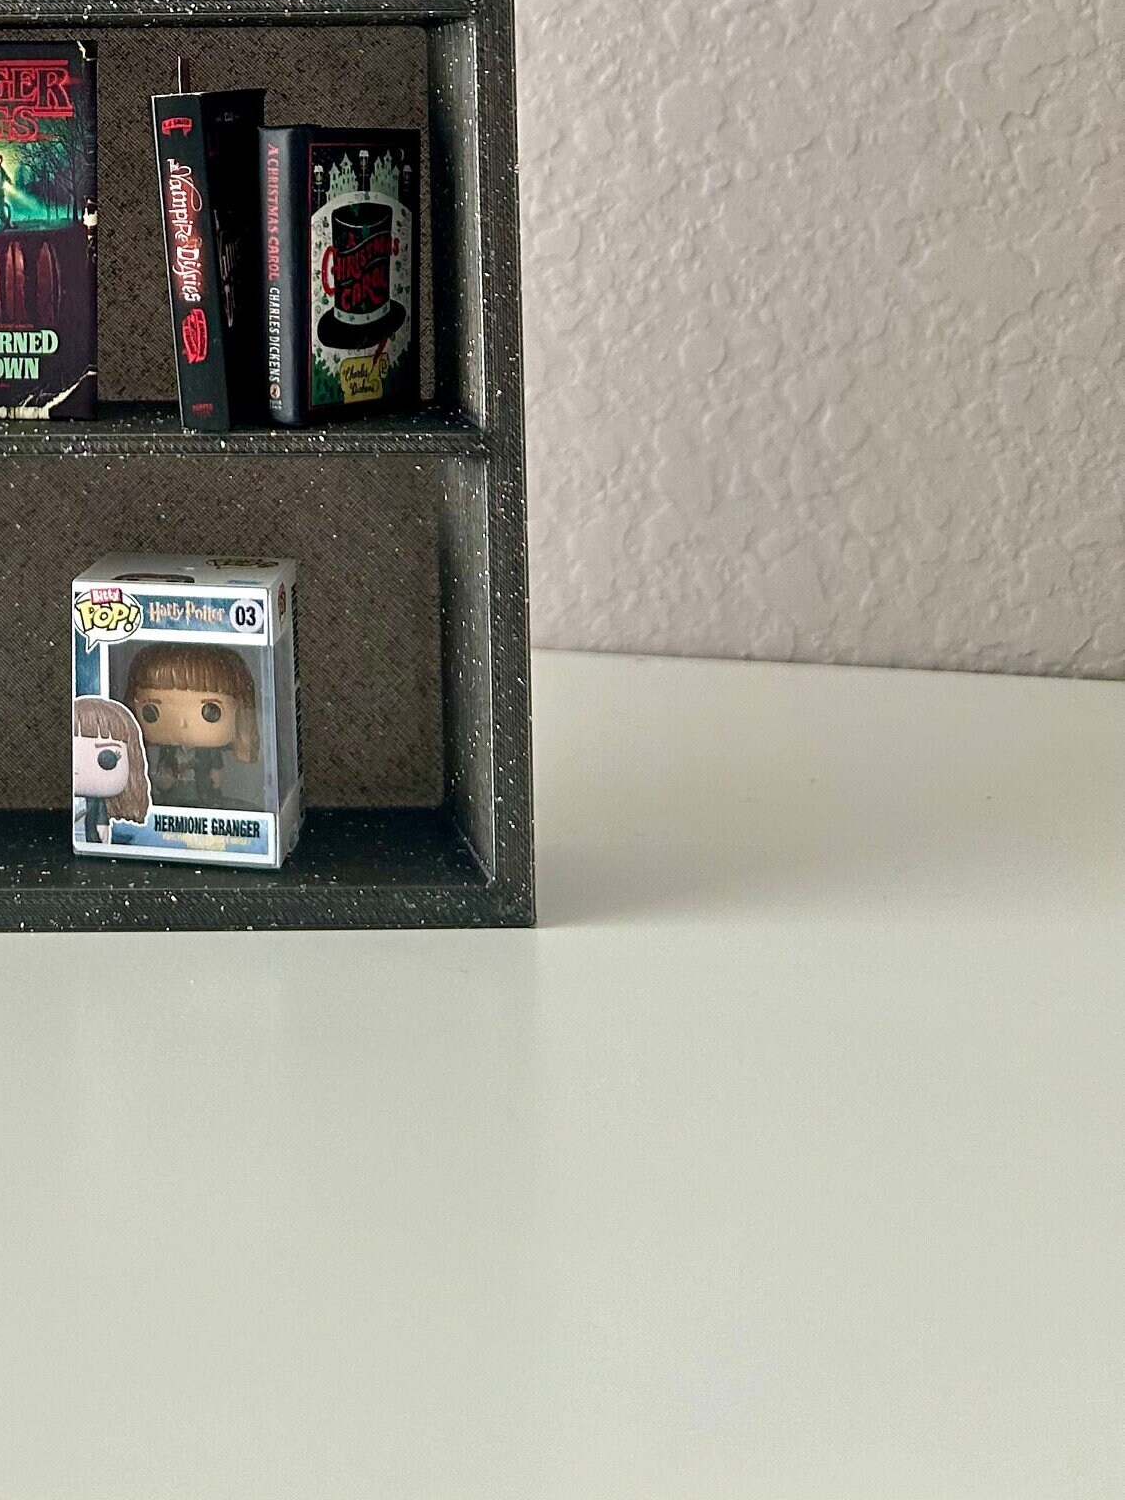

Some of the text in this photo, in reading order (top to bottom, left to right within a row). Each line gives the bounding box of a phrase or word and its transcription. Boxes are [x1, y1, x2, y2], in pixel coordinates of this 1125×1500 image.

[267, 143, 280, 281] A CHRISTMAS CAROL
[322, 236, 400, 297] CHRISTMAS
[341, 267, 388, 310] CAROL
[269, 287, 280, 383] CHARLES DICKENS
[74, 599, 140, 633] POP!
[148, 600, 226, 626] Harry Potter
[235, 605, 257, 626] 03
[154, 814, 261, 839] HERMIONE GRANGER
